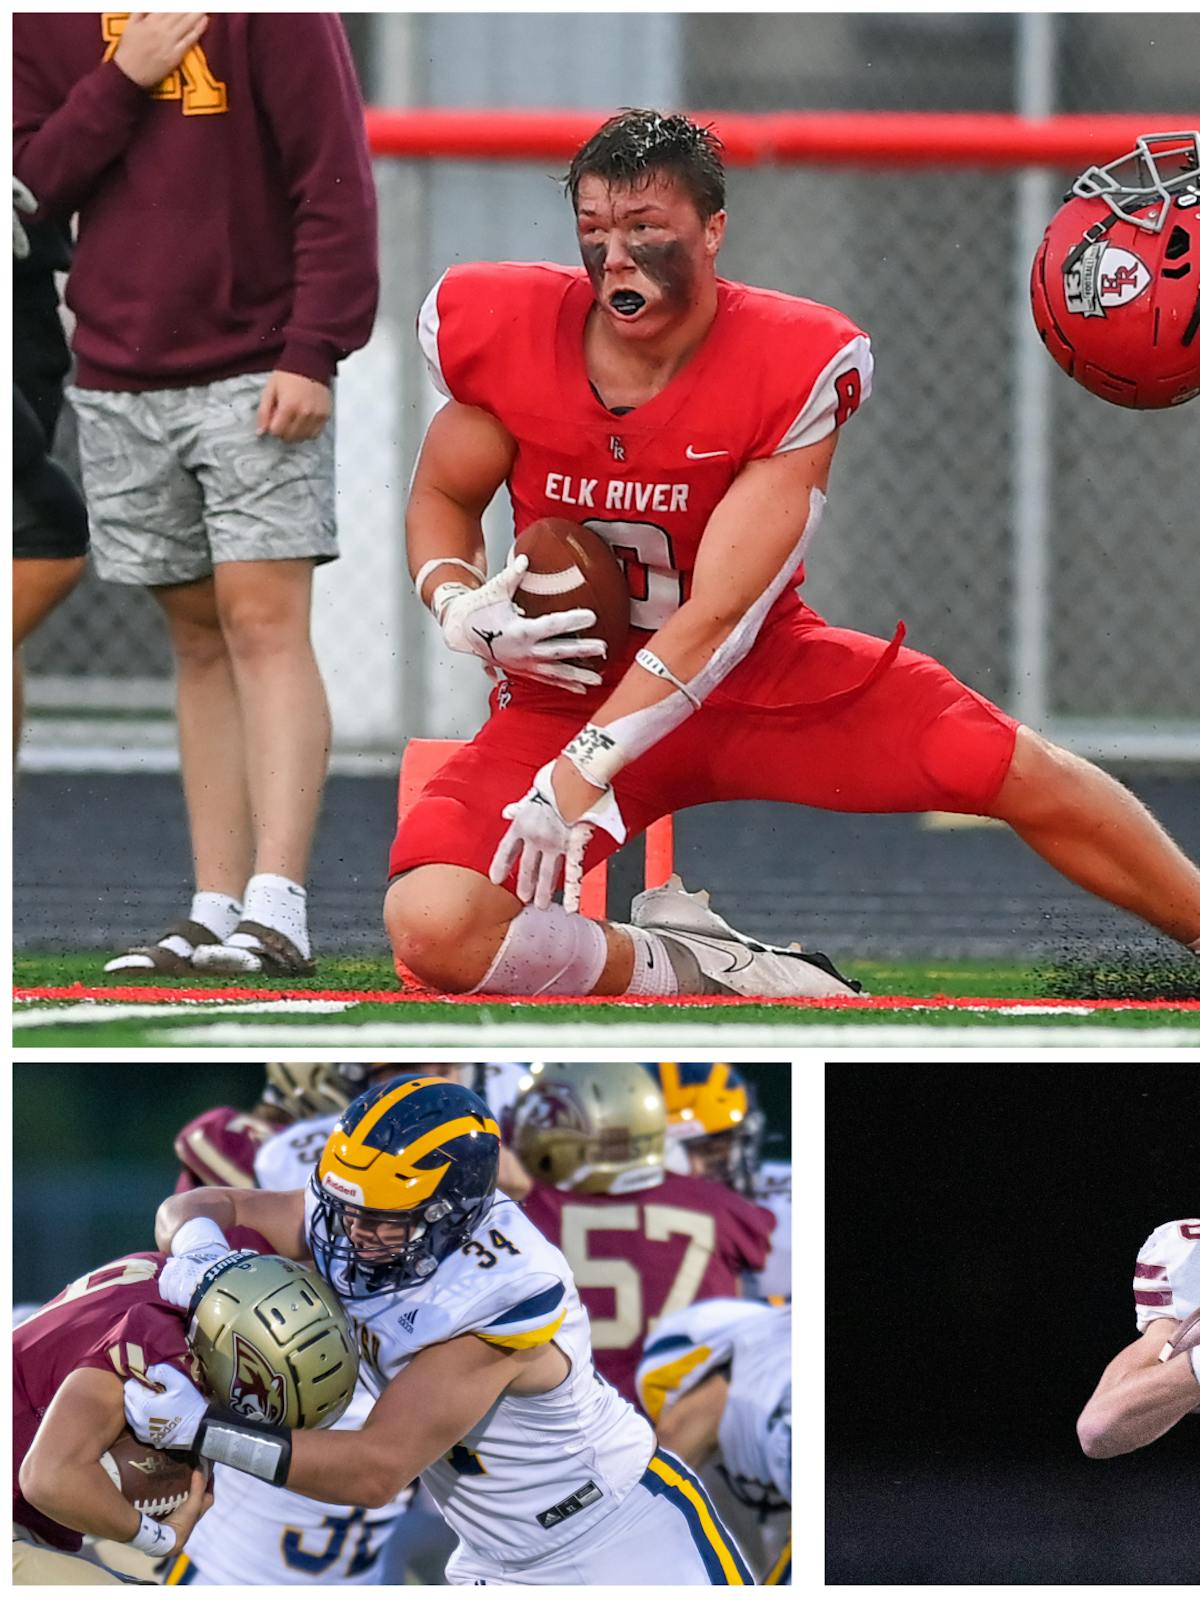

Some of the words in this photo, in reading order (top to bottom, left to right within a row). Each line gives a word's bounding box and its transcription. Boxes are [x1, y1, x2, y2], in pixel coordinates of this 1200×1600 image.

[545, 472, 599, 508] ELK
[605, 479, 690, 513] RIVER
[461, 1228, 521, 1270] 34
[561, 1203, 716, 1350] 57
